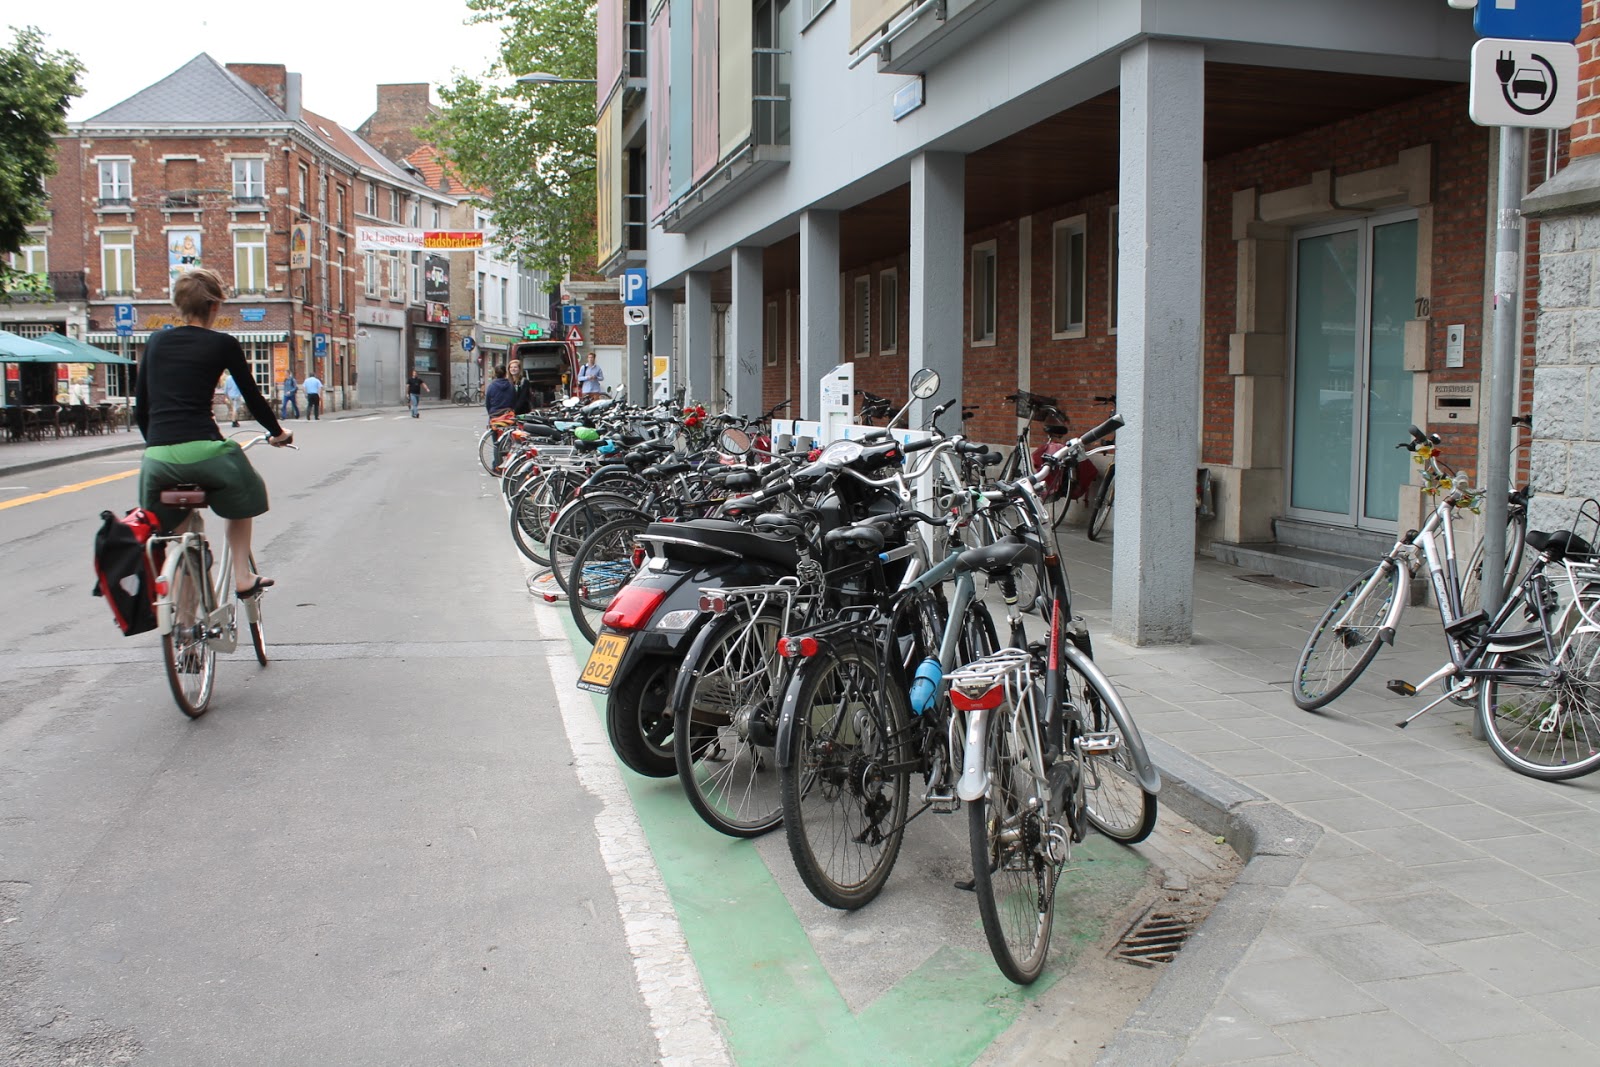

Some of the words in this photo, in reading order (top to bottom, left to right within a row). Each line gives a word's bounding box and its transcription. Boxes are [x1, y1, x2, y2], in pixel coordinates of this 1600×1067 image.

[361, 231, 372, 241] De
[375, 231, 405, 245] Langste
[407, 233, 423, 246] Dag
[424, 233, 482, 247] stadsbraderie
[627, 274, 643, 301] P
[118, 306, 128, 319] P
[1415, 297, 1430, 317] 78
[315, 336, 324, 348] P
[463, 338, 470, 347] P
[1433, 573, 1453, 624] OXFOR
[595, 640, 619, 658] WML
[586, 661, 613, 680] 802
